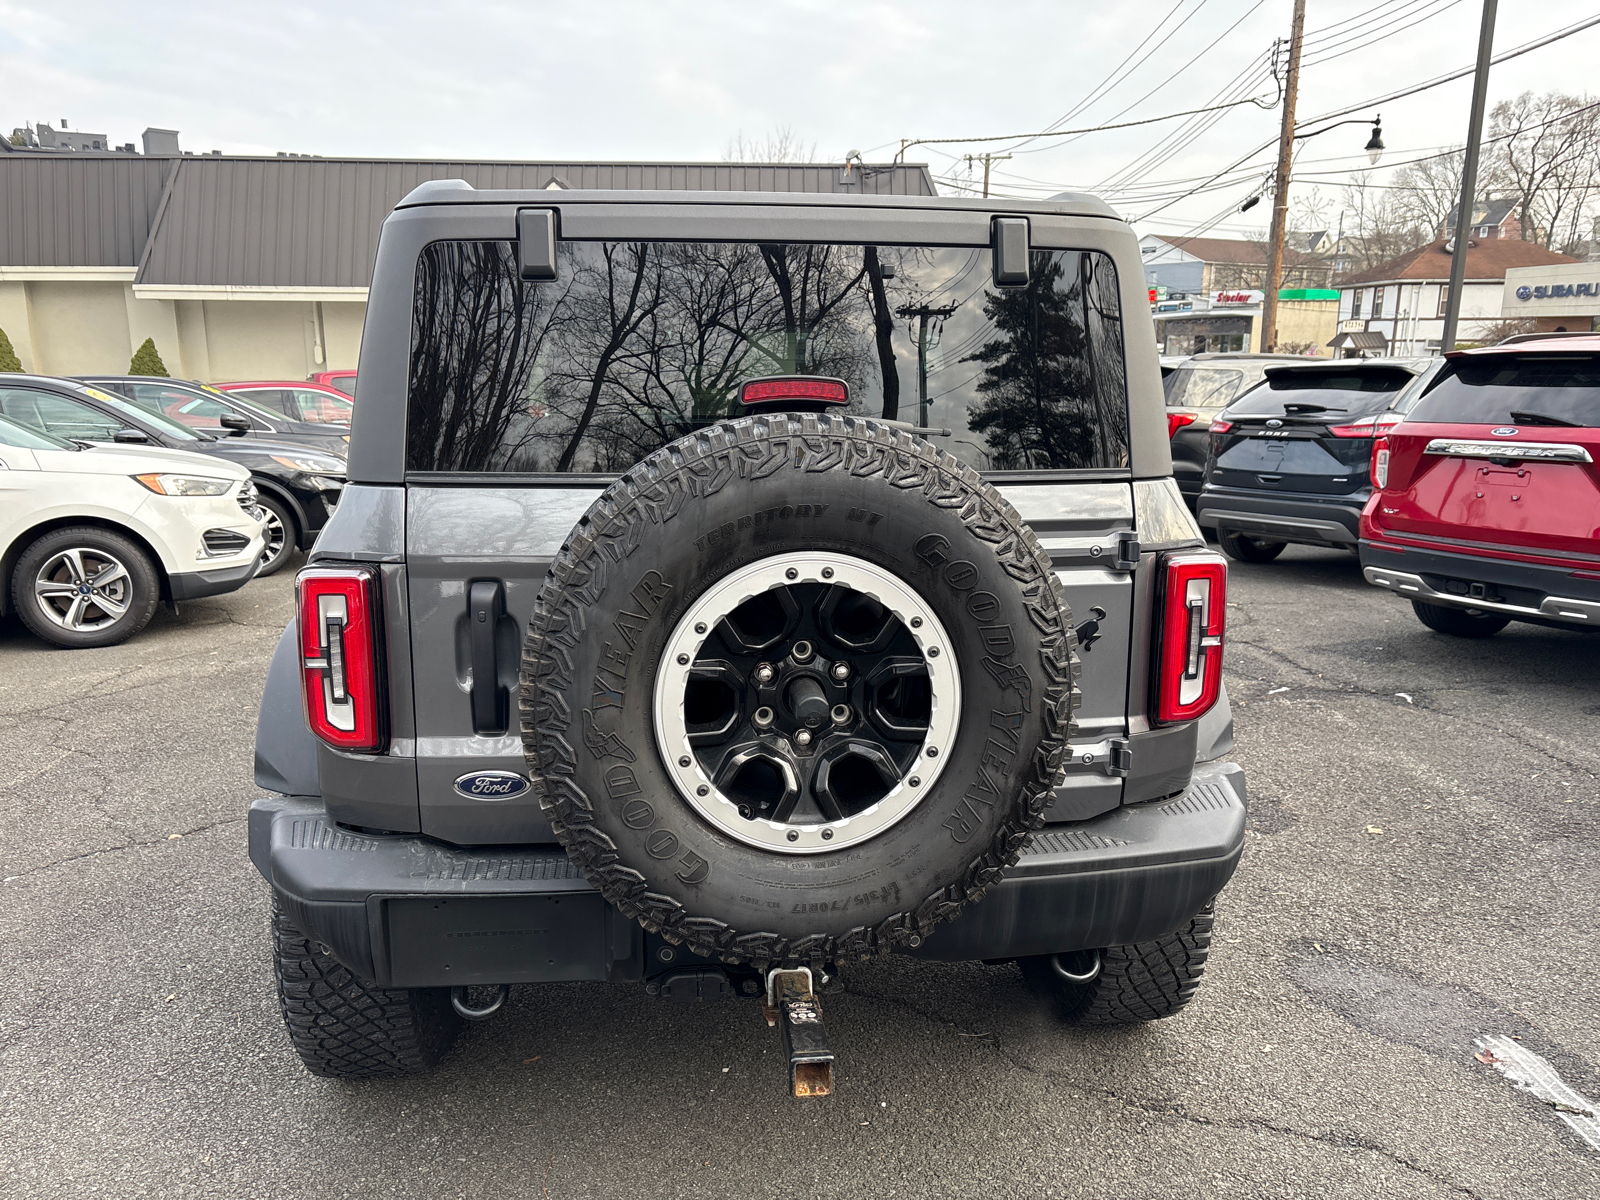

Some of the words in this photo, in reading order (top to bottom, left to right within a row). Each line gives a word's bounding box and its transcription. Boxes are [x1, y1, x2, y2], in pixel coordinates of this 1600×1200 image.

[1216, 292, 1252, 303] Sinclair
[1533, 282, 1600, 299] SUBARU
[693, 503, 829, 552] TERRITORY
[914, 533, 1028, 844] GOODYEAR
[585, 569, 712, 884] GOODYEAR
[471, 777, 518, 794] Ford
